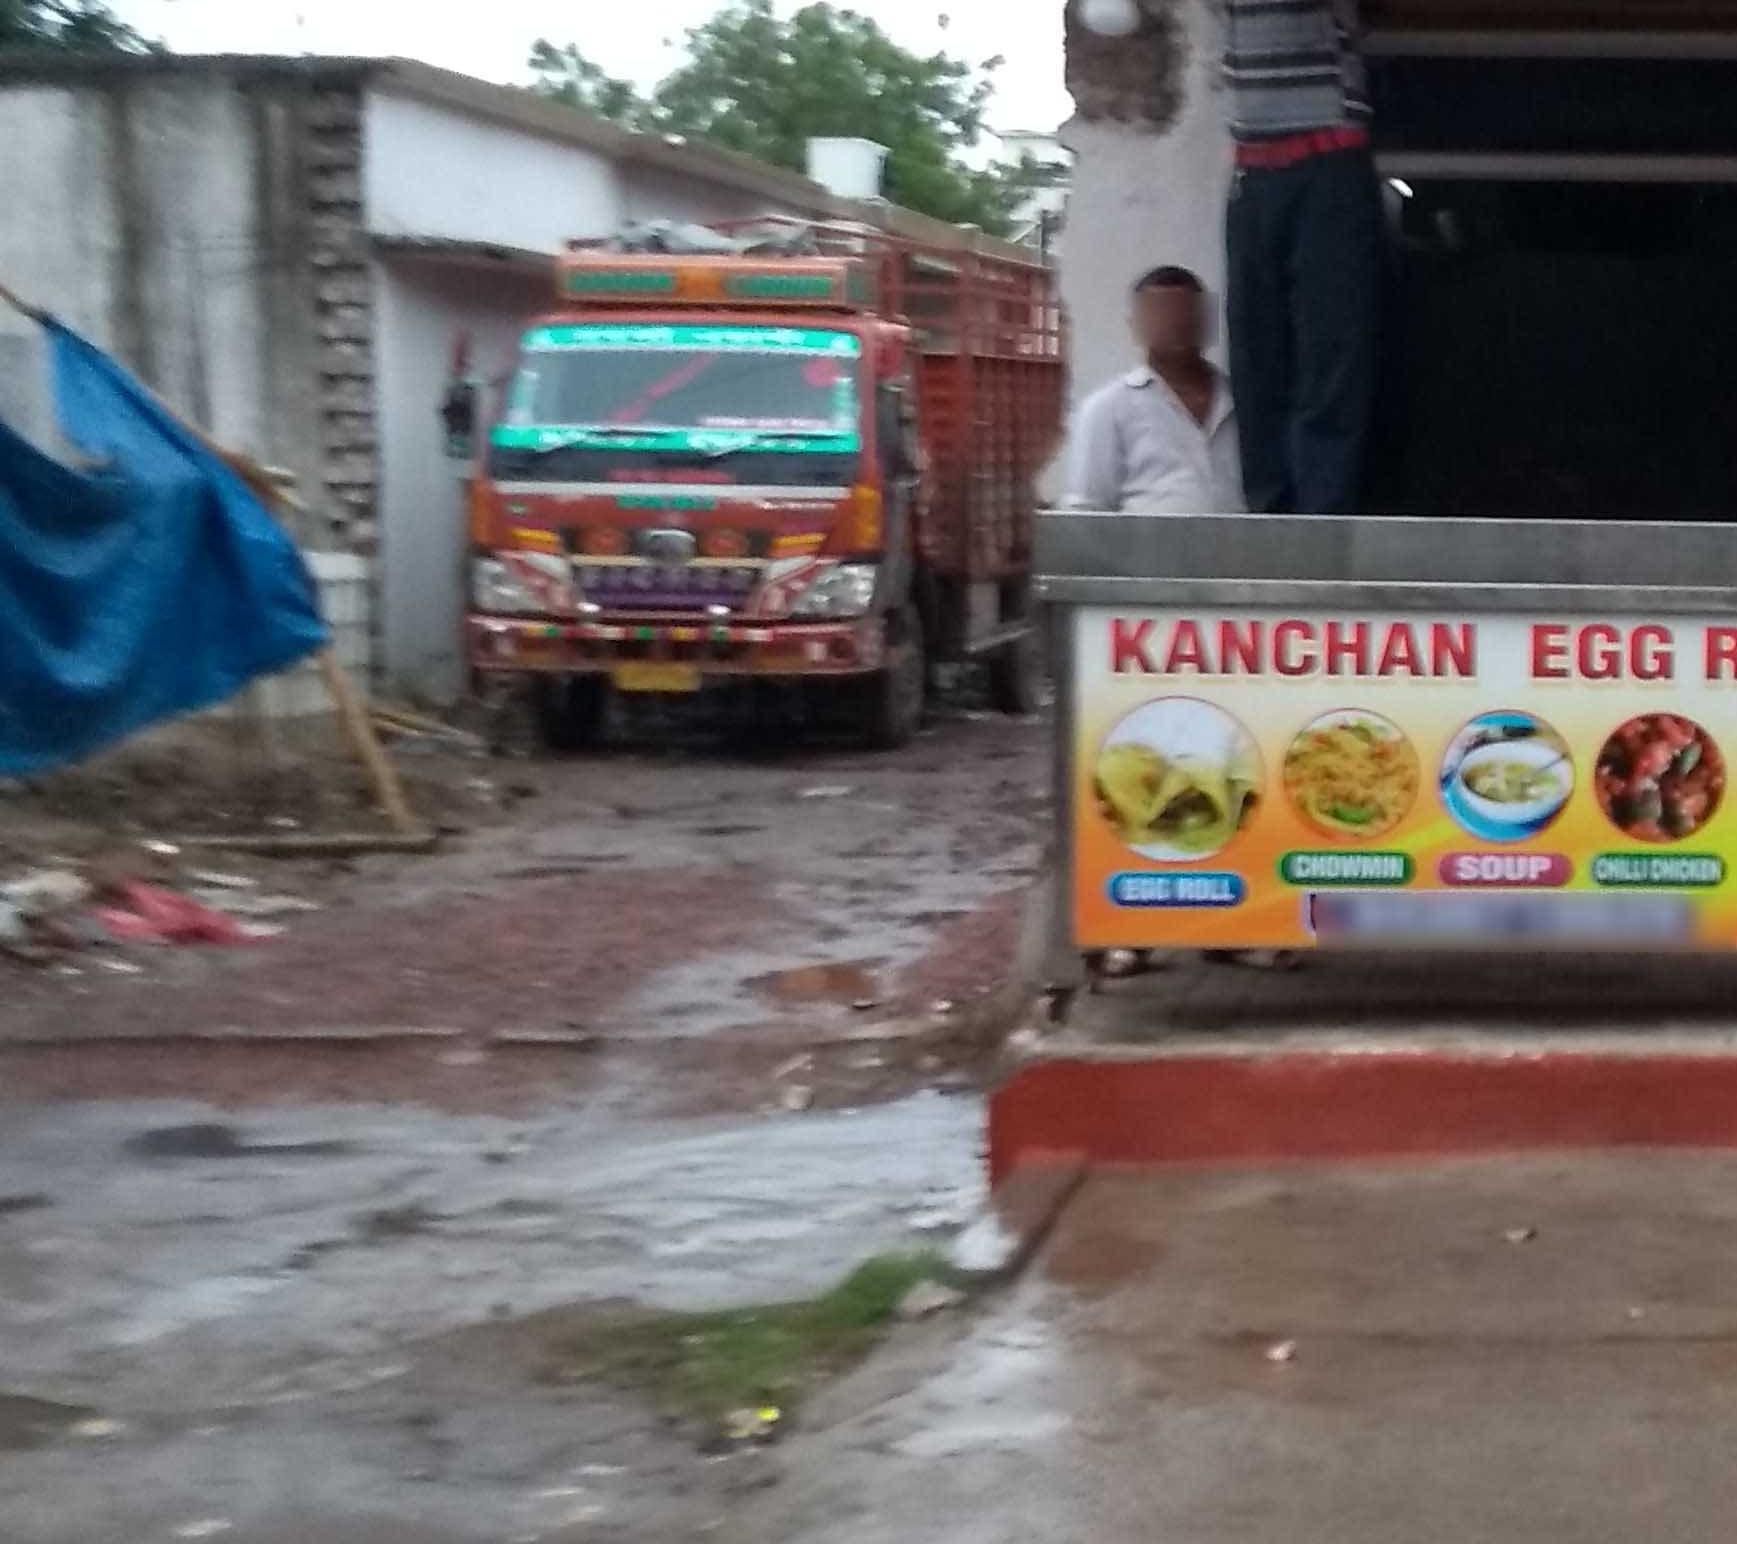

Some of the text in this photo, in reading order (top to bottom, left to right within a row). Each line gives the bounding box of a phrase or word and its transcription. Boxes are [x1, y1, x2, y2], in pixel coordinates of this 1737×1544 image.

[1109, 617, 1476, 677] KANCHAN
[1530, 622, 1674, 680] EGG
[1293, 854, 1405, 880] CHOWMIN
[1455, 855, 1552, 881] SOUP
